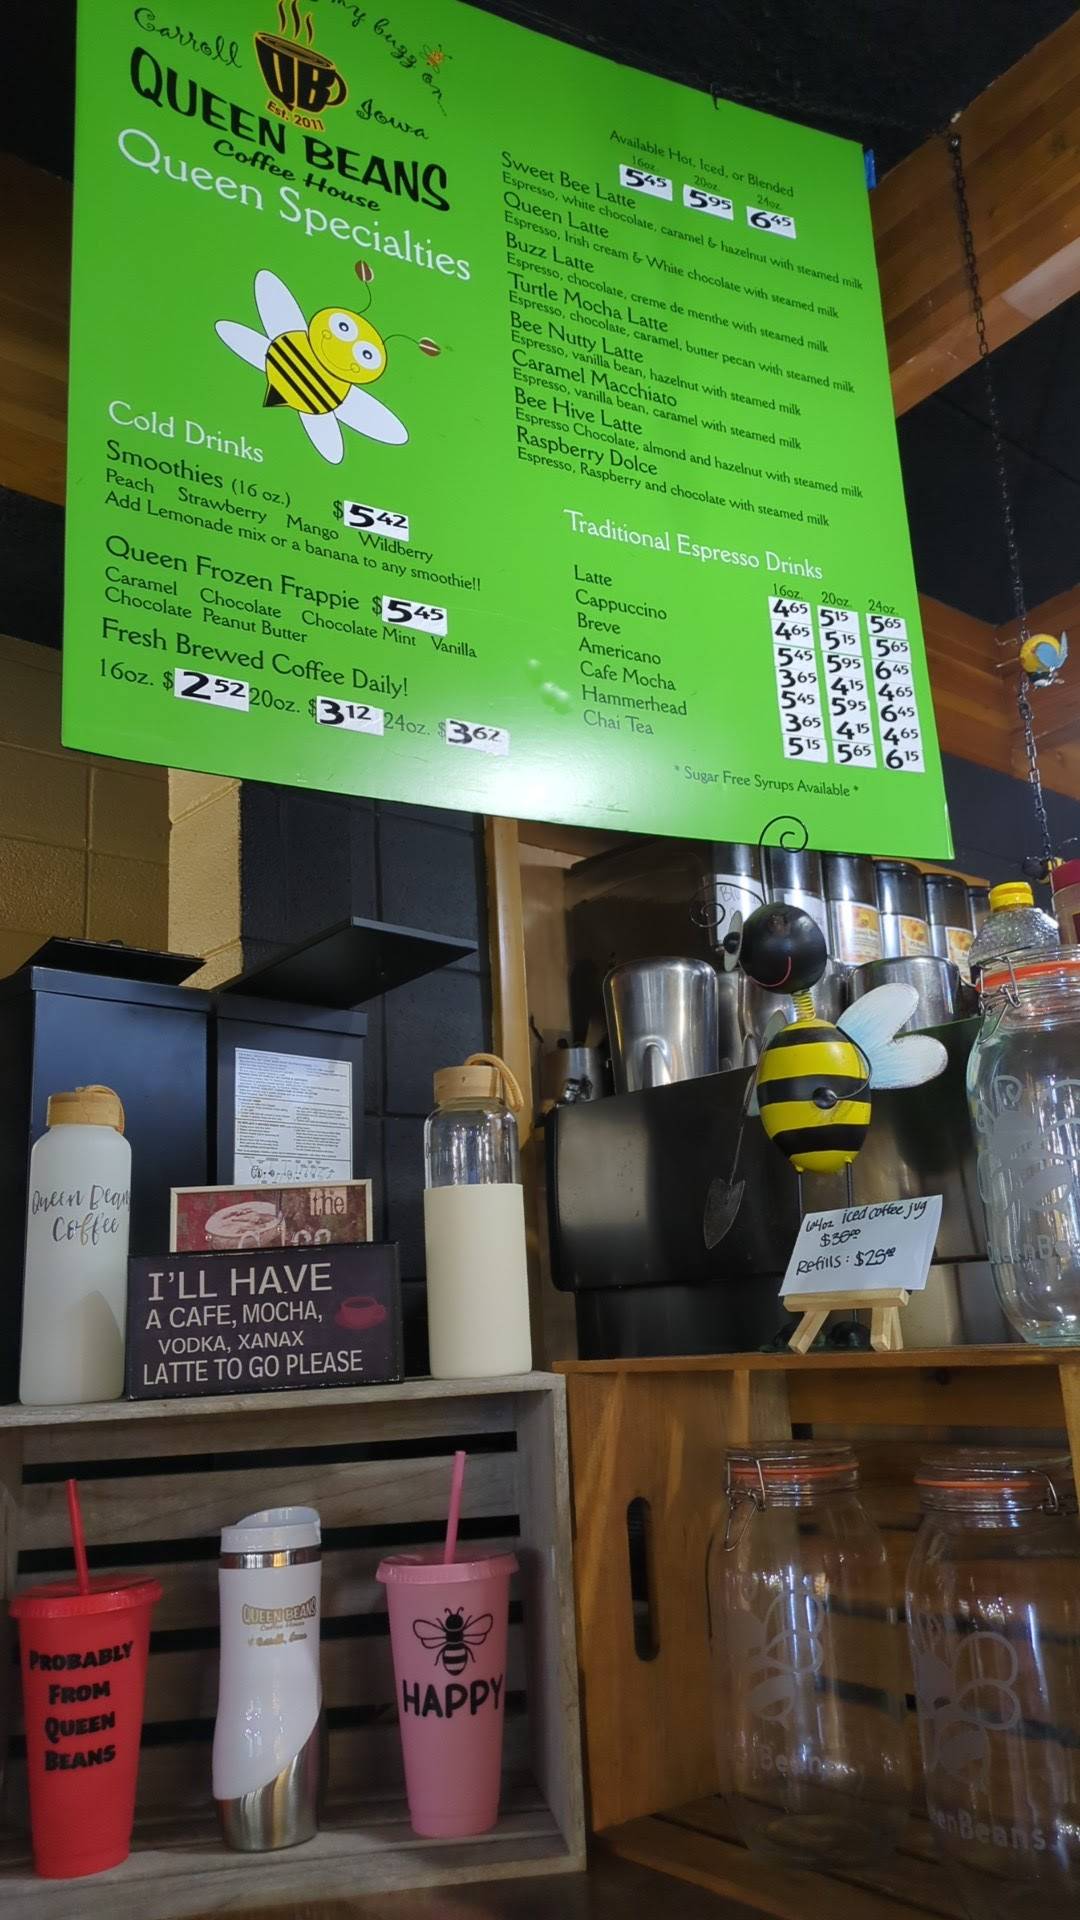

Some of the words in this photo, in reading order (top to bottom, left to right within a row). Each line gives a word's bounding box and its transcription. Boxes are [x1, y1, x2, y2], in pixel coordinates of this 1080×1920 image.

[134, 7, 242, 68] Carroll
[130, 46, 286, 155] QUEEN
[302, 136, 450, 211] BEANS
[294, 113, 325, 131] 2011
[356, 99, 429, 140] Iowa
[214, 139, 296, 181] Coffee
[302, 173, 381, 212] House
[501, 150, 555, 184] Sweet
[560, 170, 590, 195] Bee
[596, 182, 637, 209] Latte
[609, 129, 665, 157] Available
[733, 173, 745, 182] or
[748, 173, 794, 198] Blended
[118, 129, 264, 211] Queen
[280, 186, 471, 280] Specialties
[504, 191, 563, 225] Queen
[568, 211, 610, 239] Latte
[505, 230, 547, 259] Buzz
[552, 245, 595, 273] Latte
[507, 271, 558, 300] Turtle
[563, 287, 623, 321] Mocha
[627, 306, 669, 333] Latte
[510, 310, 543, 335] Bee
[548, 321, 597, 352] Nutty
[601, 336, 645, 364] Latte
[511, 348, 585, 384] Caramel
[591, 369, 678, 408] Macchiato
[108, 400, 175, 438] Cold
[185, 420, 264, 463] Drinks
[514, 386, 547, 411] Bee
[552, 396, 596, 424] Hive
[600, 408, 643, 436] Latte
[106, 439, 224, 489] Smoothies
[515, 406, 569, 433] Espresso
[573, 422, 639, 451] Chocolate,
[642, 440, 686, 462] almond
[689, 454, 711, 468] and
[714, 455, 763, 479] hazelnut
[765, 469, 791, 484] with
[793, 475, 838, 494] steamed
[841, 484, 863, 499] milk
[516, 425, 604, 466] Raspberry
[609, 448, 658, 476] Dolce
[517, 446, 576, 474] Espresso,
[580, 461, 641, 491] Raspberry
[645, 480, 667, 493] and
[670, 484, 726, 507] chocolate
[729, 499, 755, 513] with
[758, 503, 804, 522] steamed
[806, 513, 830, 527] milk
[106, 467, 155, 494] Peach
[178, 486, 267, 524] Strawberry
[286, 514, 339, 541] Mango
[358, 531, 433, 565] Wildberry
[104, 490, 141, 512] Add
[147, 499, 233, 535] Lemonade
[238, 527, 266, 543] mix
[271, 535, 287, 548] or
[291, 541, 300, 552] a
[304, 539, 359, 565] banana
[363, 556, 377, 568] to
[382, 561, 406, 577] any
[411, 566, 481, 592] smoothie!!
[563, 508, 671, 552] Traditional
[676, 532, 760, 569] Espresso
[765, 549, 824, 581] Drinks
[105, 535, 188, 573] Queen
[195, 554, 272, 592] Frozen
[280, 574, 360, 611] Frappie
[573, 564, 613, 588] Latte
[104, 586, 192, 619] Chocolate
[203, 607, 257, 633] Peanut
[261, 619, 308, 643] Butter
[105, 566, 178, 596] Caramel
[200, 587, 282, 618] Chocolate
[301, 610, 378, 638] Chocolate
[382, 626, 416, 647] Mint
[430, 636, 478, 658] Vanilla
[575, 587, 668, 621] Cappuccino
[577, 611, 621, 635] Breve
[102, 616, 168, 651] Fresh
[176, 632, 264, 670] Brewed
[271, 653, 345, 685] Coffee
[352, 668, 408, 699] Daily!
[578, 636, 662, 666] Americano
[580, 660, 618, 681] Cafe
[622, 667, 676, 691] Mocha
[99, 658, 155, 686] 16oz.
[248, 686, 300, 714] 20oz.
[582, 684, 688, 716] Hammerhead
[583, 709, 620, 730] Chai
[625, 715, 654, 735] Tea
[684, 765, 719, 785] Sugar
[722, 769, 751, 786] Free
[754, 775, 794, 793] Syrups
[797, 778, 850, 797] Available
[53, 1212, 120, 1246] Coffee
[842, 1206, 868, 1224] iced
[868, 1203, 904, 1221] coffee
[904, 1200, 928, 1220] jug
[147, 1270, 218, 1301] I'LL
[230, 1262, 333, 1297] HAVE
[145, 1308, 162, 1330] A
[169, 1304, 237, 1328] CAFE,
[242, 1300, 322, 1323] MOCHA,
[158, 1335, 232, 1355] VODKA,
[238, 1330, 304, 1350] XANAX
[143, 1359, 209, 1386] LATTE
[213, 1358, 243, 1380] TO
[249, 1354, 280, 1378] GO
[286, 1349, 364, 1376] PLEASE
[29, 1640, 134, 1672] PROBABLY
[48, 1680, 111, 1706] FROM
[402, 1674, 503, 1718] HAPPY
[44, 1711, 116, 1744] QUEEN
[44, 1744, 116, 1772] BEANS
